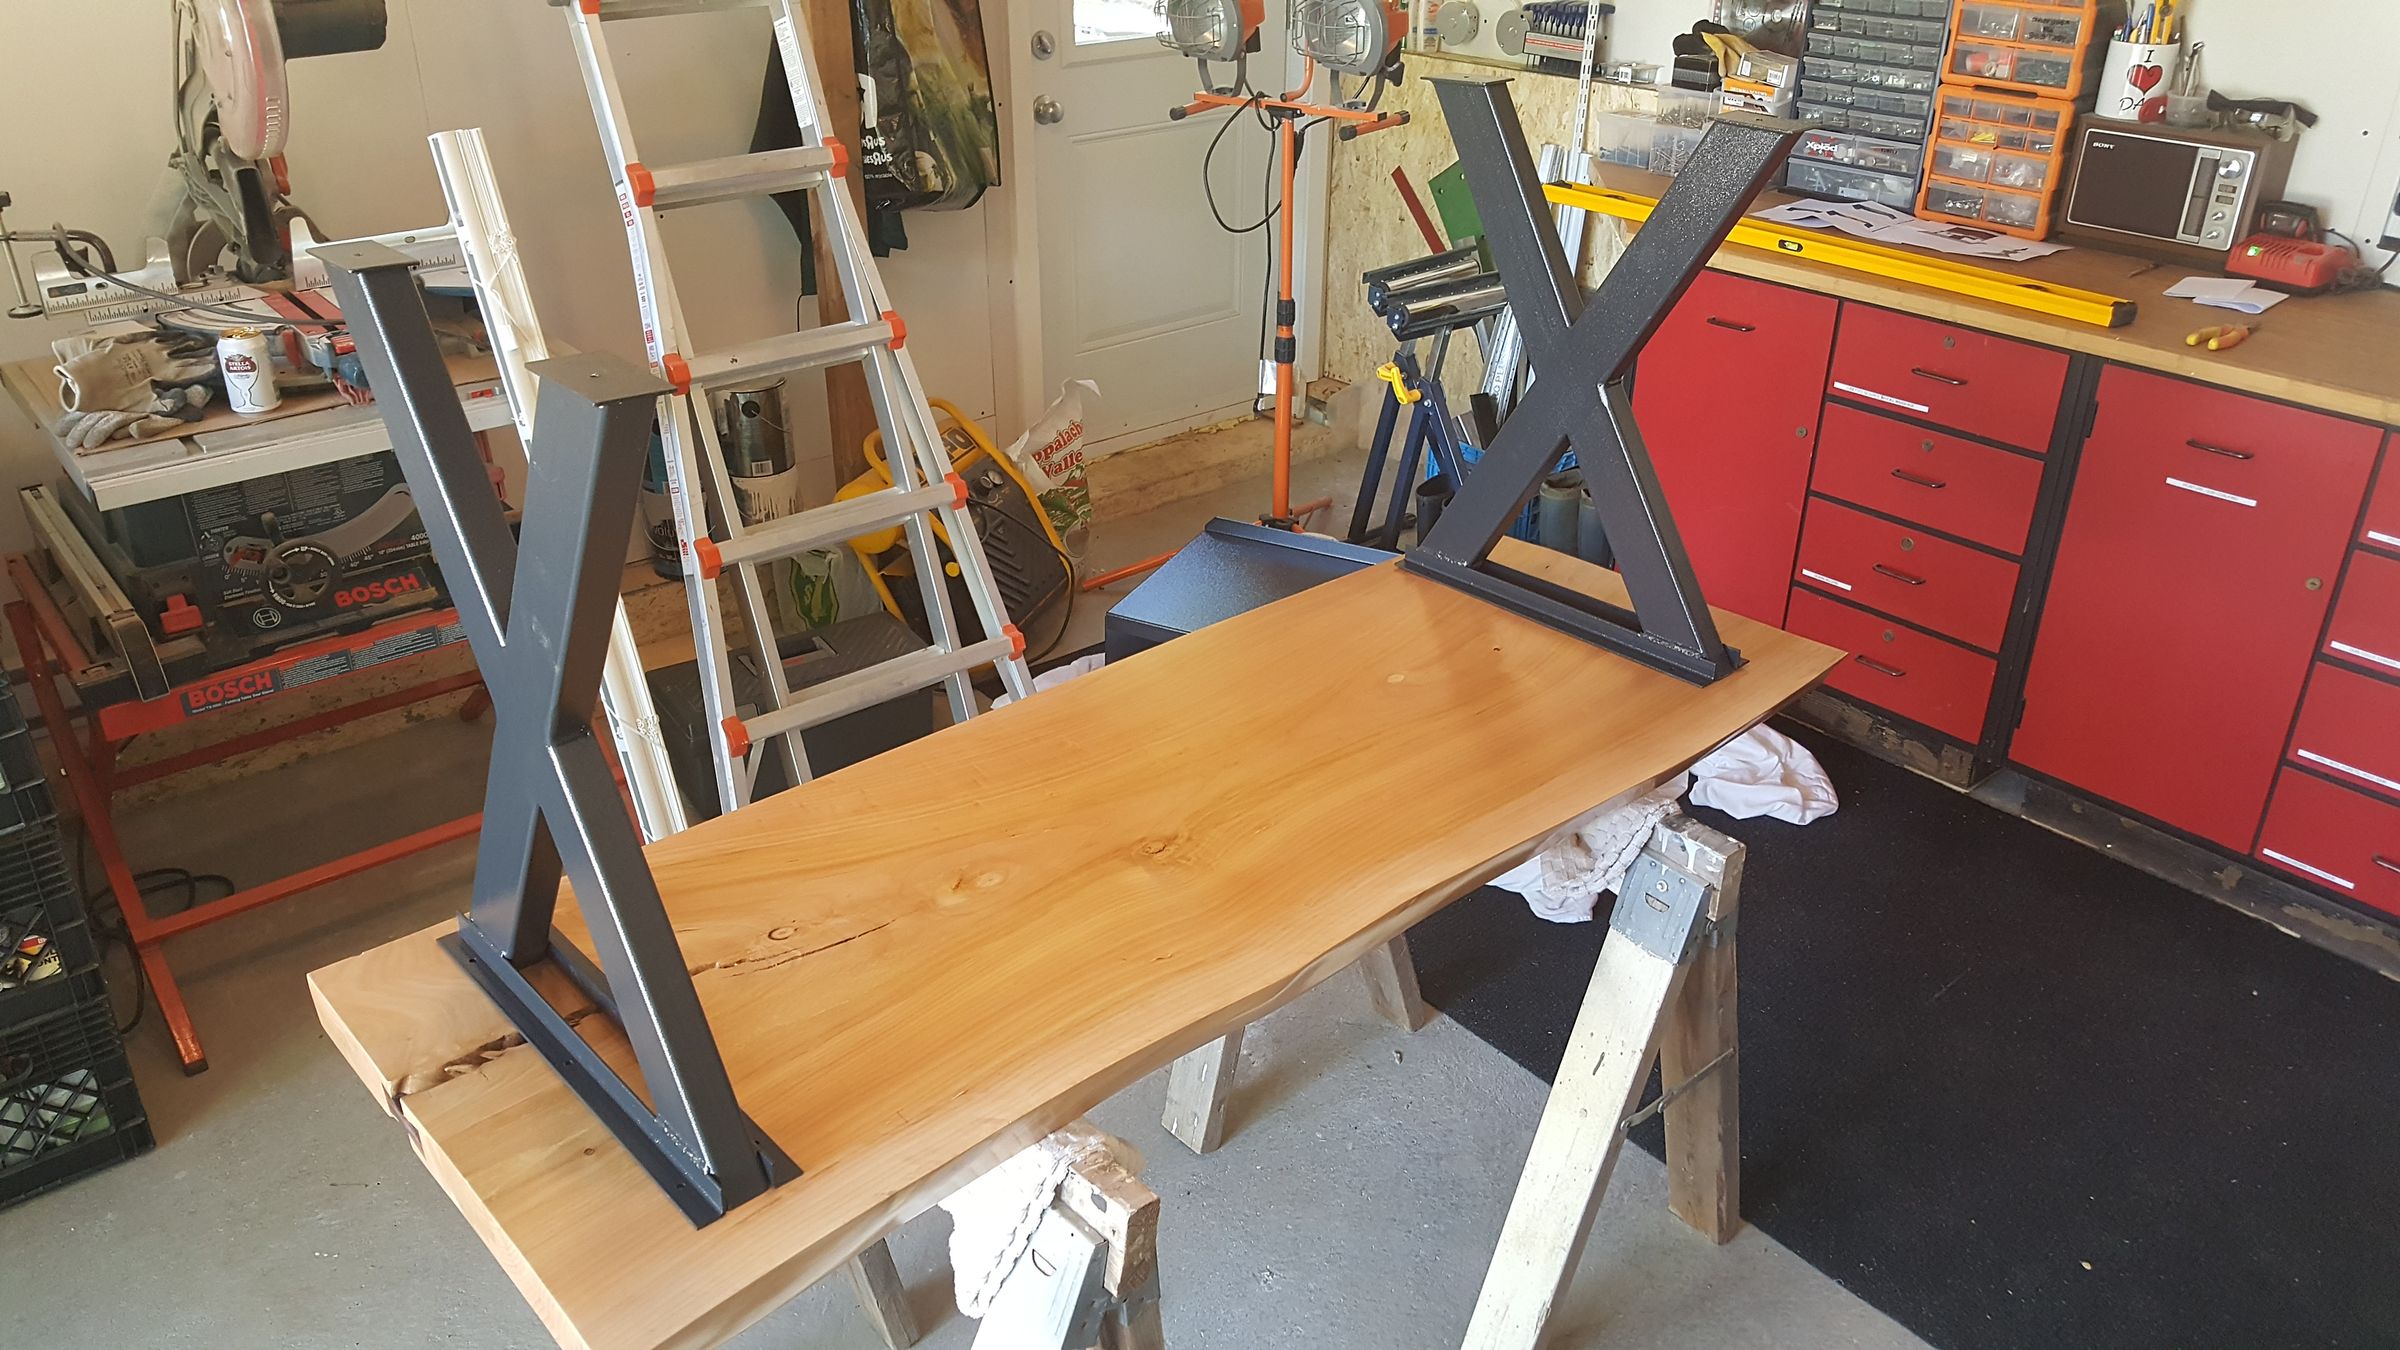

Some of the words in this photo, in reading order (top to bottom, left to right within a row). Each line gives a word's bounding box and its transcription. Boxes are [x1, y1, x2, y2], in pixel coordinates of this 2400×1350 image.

[2144, 49, 2155, 63] I
[2119, 96, 2146, 111] DA
[1032, 420, 1085, 464] ppalach
[1042, 451, 1084, 479] Valle
[334, 573, 420, 608] BOSCH
[187, 671, 273, 708] BOSCH
